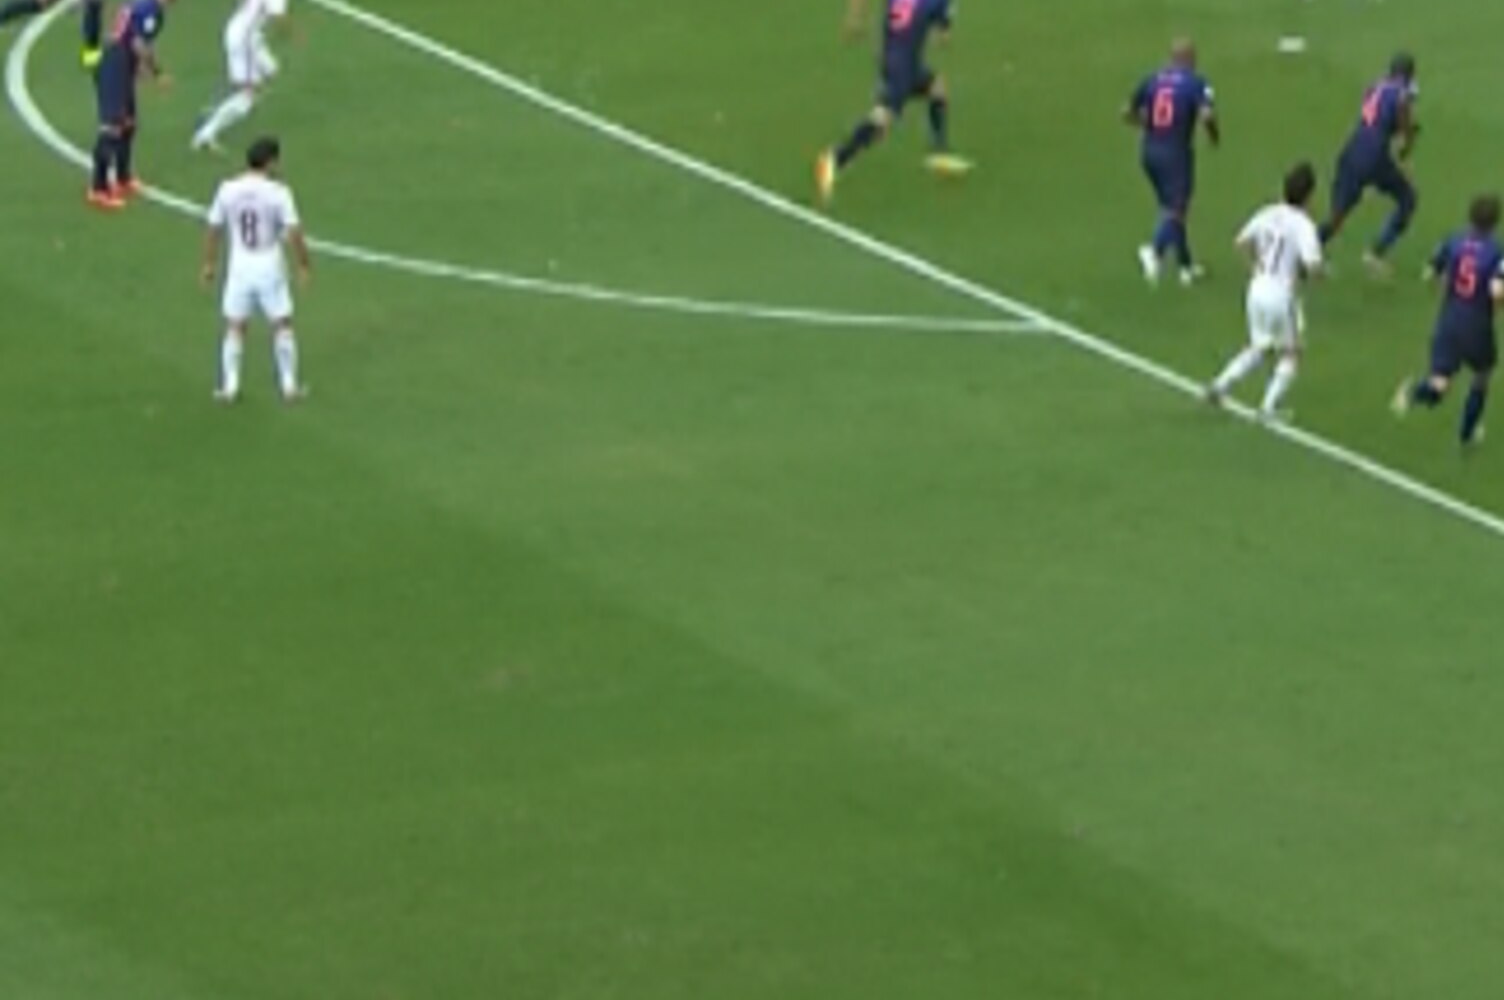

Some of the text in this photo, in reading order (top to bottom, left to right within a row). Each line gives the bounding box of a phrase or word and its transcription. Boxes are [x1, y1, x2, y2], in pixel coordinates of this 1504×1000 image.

[1152, 85, 1175, 128] 6
[240, 208, 258, 249] 8
[1456, 253, 1479, 299] 5
